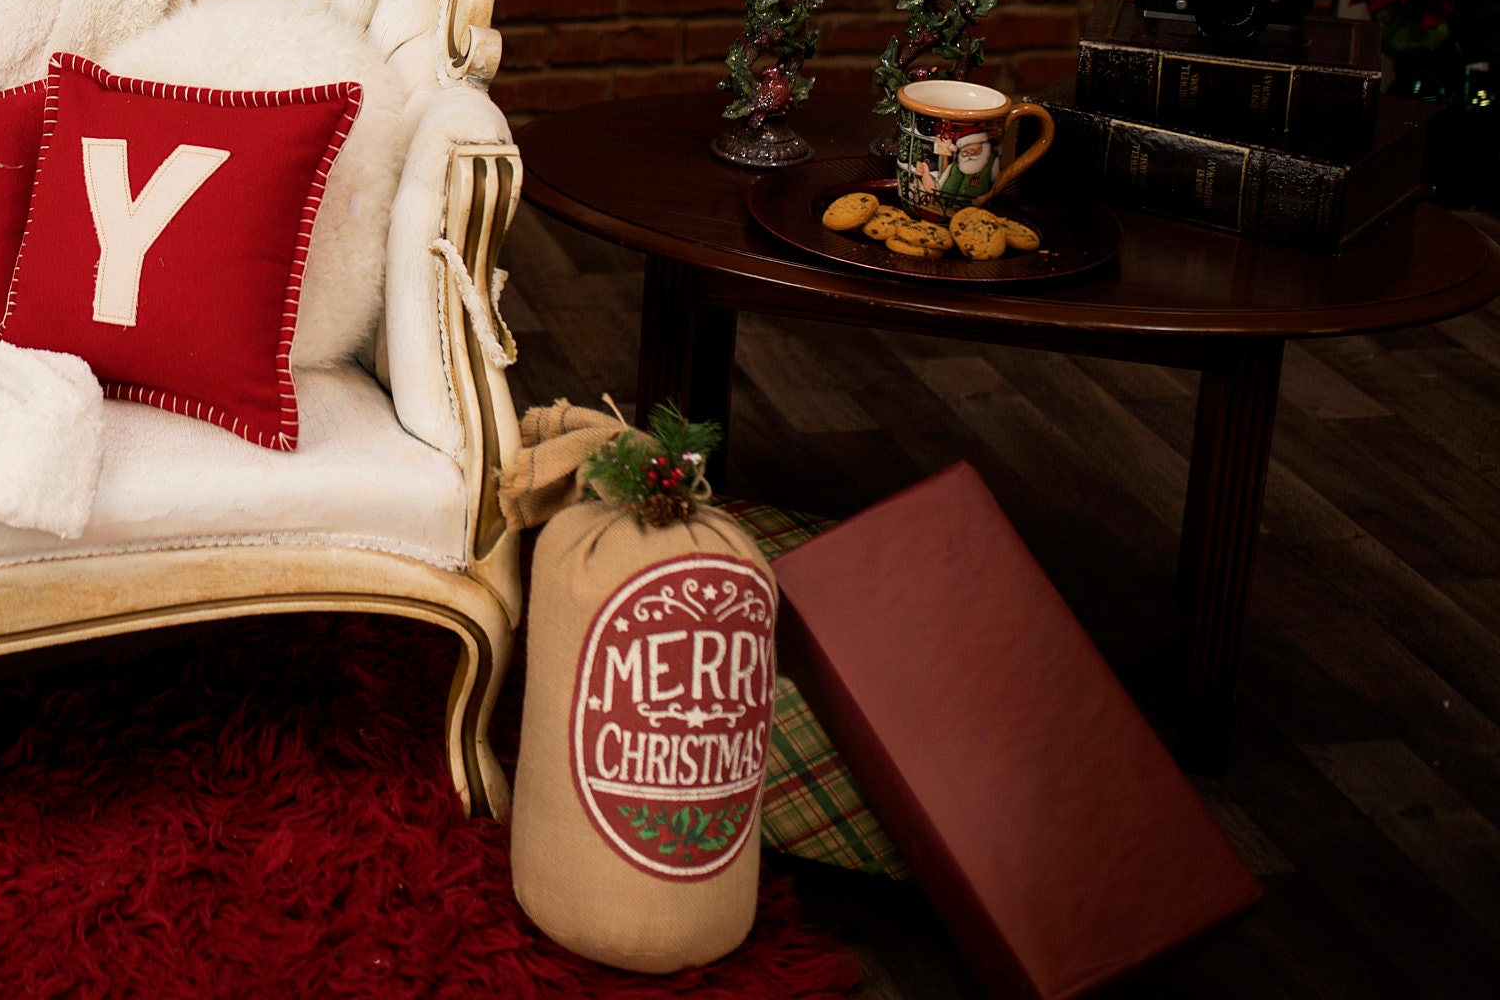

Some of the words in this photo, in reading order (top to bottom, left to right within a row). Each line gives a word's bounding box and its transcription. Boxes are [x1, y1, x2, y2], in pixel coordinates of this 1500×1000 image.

[1178, 64, 1192, 108] REWELL
[1189, 73, 1200, 96] ARMS
[1259, 74, 1274, 120] MINGWAY
[1139, 153, 1149, 176] ARMS
[603, 630, 771, 713] MERRY
[595, 721, 766, 785] CHRISTMAS
